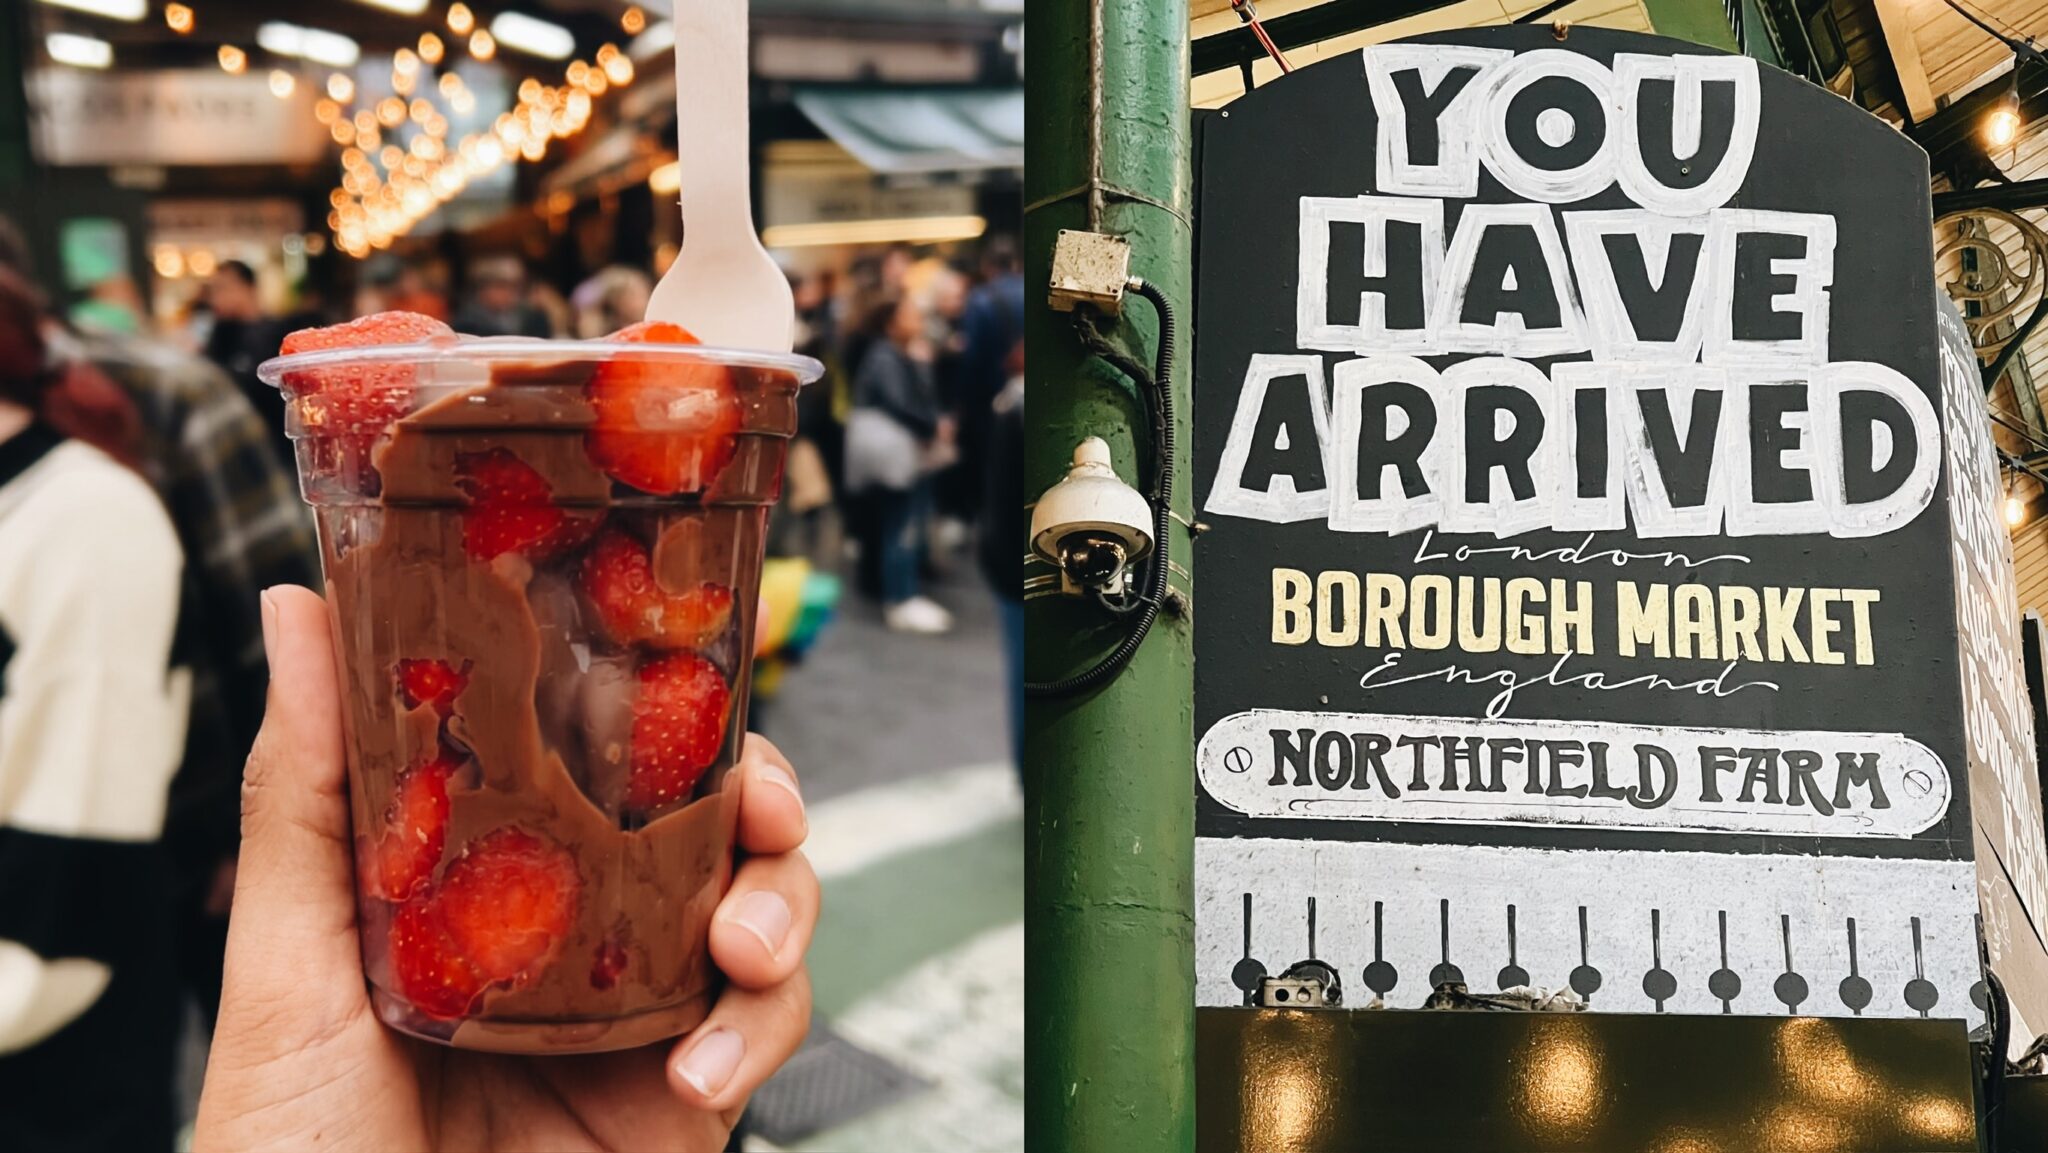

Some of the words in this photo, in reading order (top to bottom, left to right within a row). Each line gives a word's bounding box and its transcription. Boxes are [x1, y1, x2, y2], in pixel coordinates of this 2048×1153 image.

[1364, 44, 1760, 215] YOU
[1297, 195, 1837, 366] HAVE
[1204, 354, 1942, 537] ARRIVED
[1271, 567, 1593, 659] BOROUGH
[1617, 580, 1880, 666] MARKET
[1414, 530, 1750, 567] London
[1360, 650, 1779, 719] England
[1954, 541, 2015, 740] Rutland
[1268, 728, 1678, 810] NORTHFIELD
[1697, 746, 1887, 816] FARM
[1967, 653, 2032, 852] Borough
